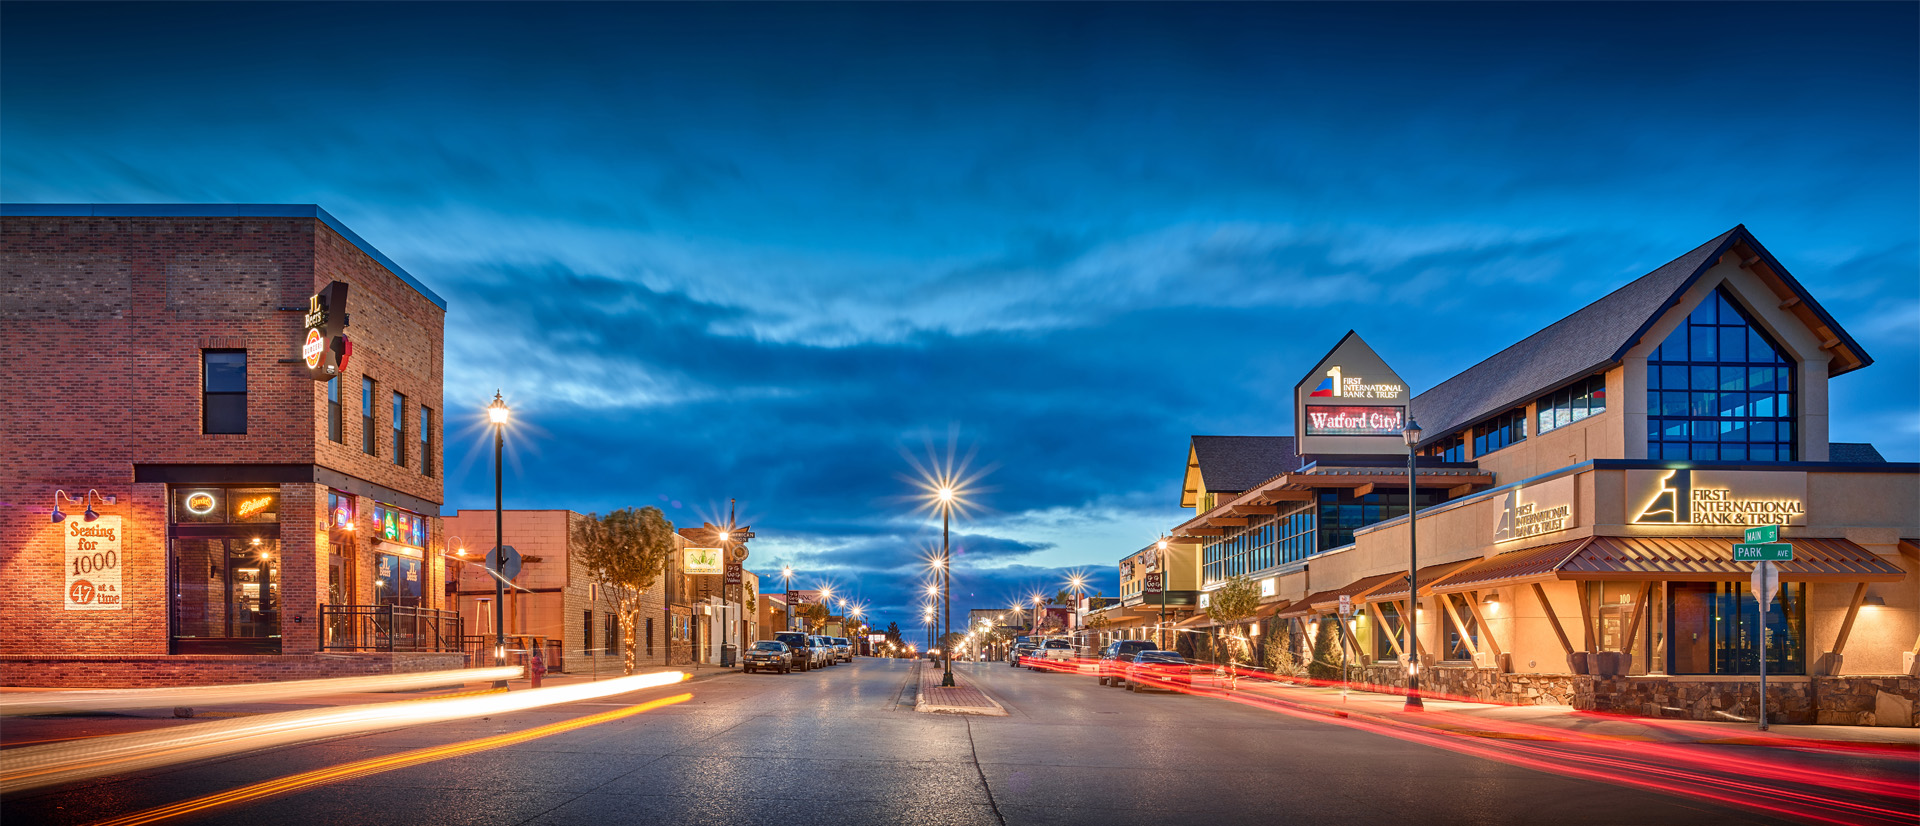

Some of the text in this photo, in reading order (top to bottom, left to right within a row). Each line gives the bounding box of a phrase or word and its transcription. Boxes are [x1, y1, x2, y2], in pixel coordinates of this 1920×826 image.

[305, 312, 322, 328] Beers
[1310, 412, 1401, 432] Watford City!
[1693, 489, 1730, 500] FIRST
[1516, 503, 1533, 515] FIRST
[1693, 501, 1804, 513] INTERNATIONAL
[1516, 506, 1569, 527] INTERNATIONAL
[1693, 513, 1792, 524] BANK & TRUST
[70, 521, 115, 541] Seating
[1516, 518, 1563, 537] BANK & TRUST
[1747, 531, 1761, 541] MAIN
[78, 538, 98, 550] for
[1738, 547, 1762, 557] PARK
[73, 550, 116, 576] 1000
[98, 583, 107, 591] at
[72, 585, 92, 603] 47
[97, 593, 119, 604] time
[1620, 594, 1630, 604] 100
